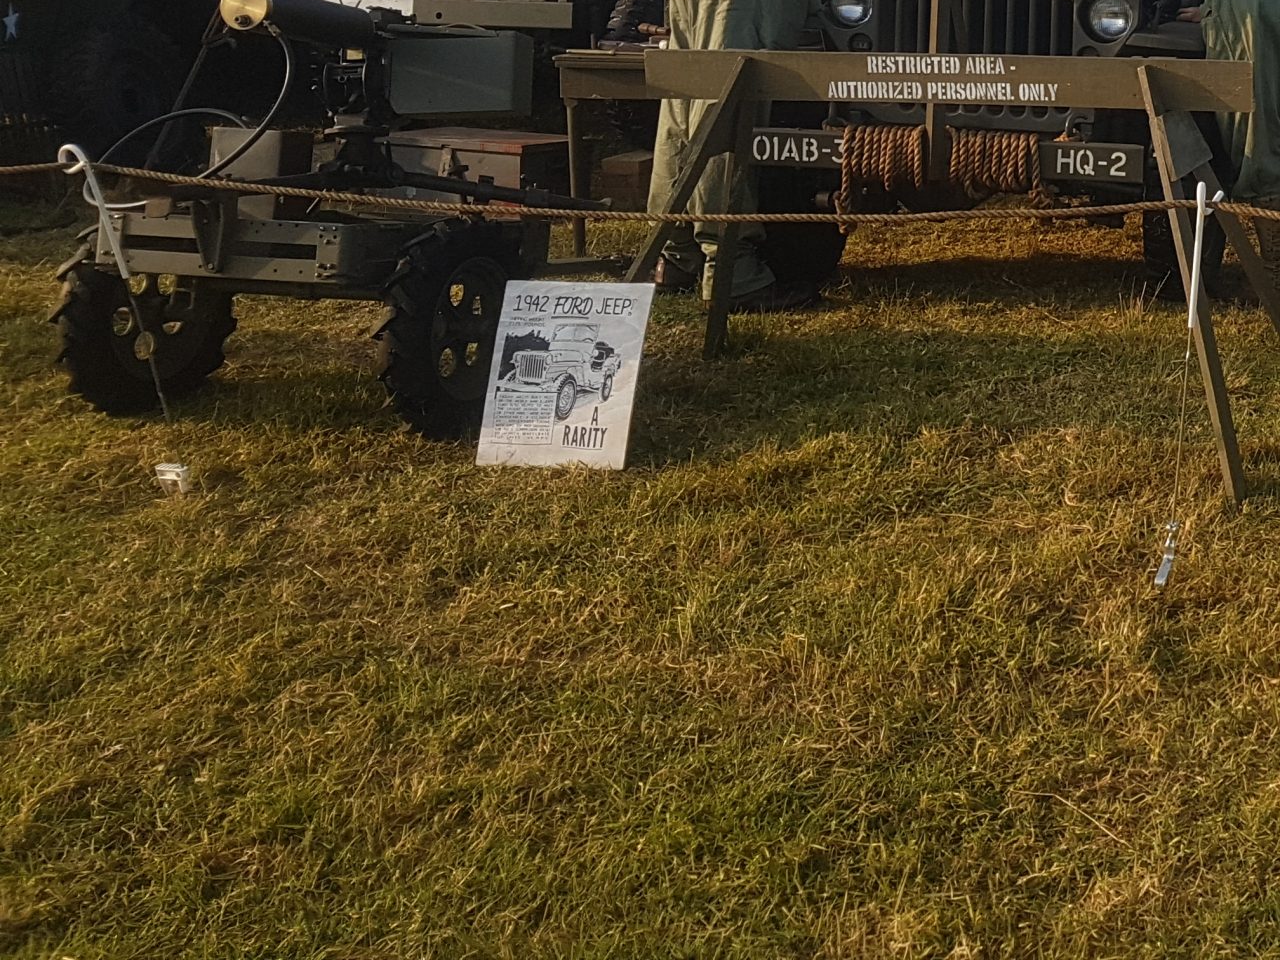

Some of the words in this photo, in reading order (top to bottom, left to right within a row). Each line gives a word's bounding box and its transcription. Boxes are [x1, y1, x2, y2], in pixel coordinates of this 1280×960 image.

[866, 56, 961, 74] RESTRICTED
[965, 56, 1006, 75] AREA
[828, 81, 923, 99] AUTHORIZED
[927, 82, 1015, 101] PERSONNEL
[1018, 83, 1059, 102] ONLY
[1056, 148, 1127, 177] HQ-2
[513, 294, 550, 313] 1942
[553, 296, 594, 317] FORD
[590, 406, 599, 426] A
[562, 424, 608, 449] RARITY
